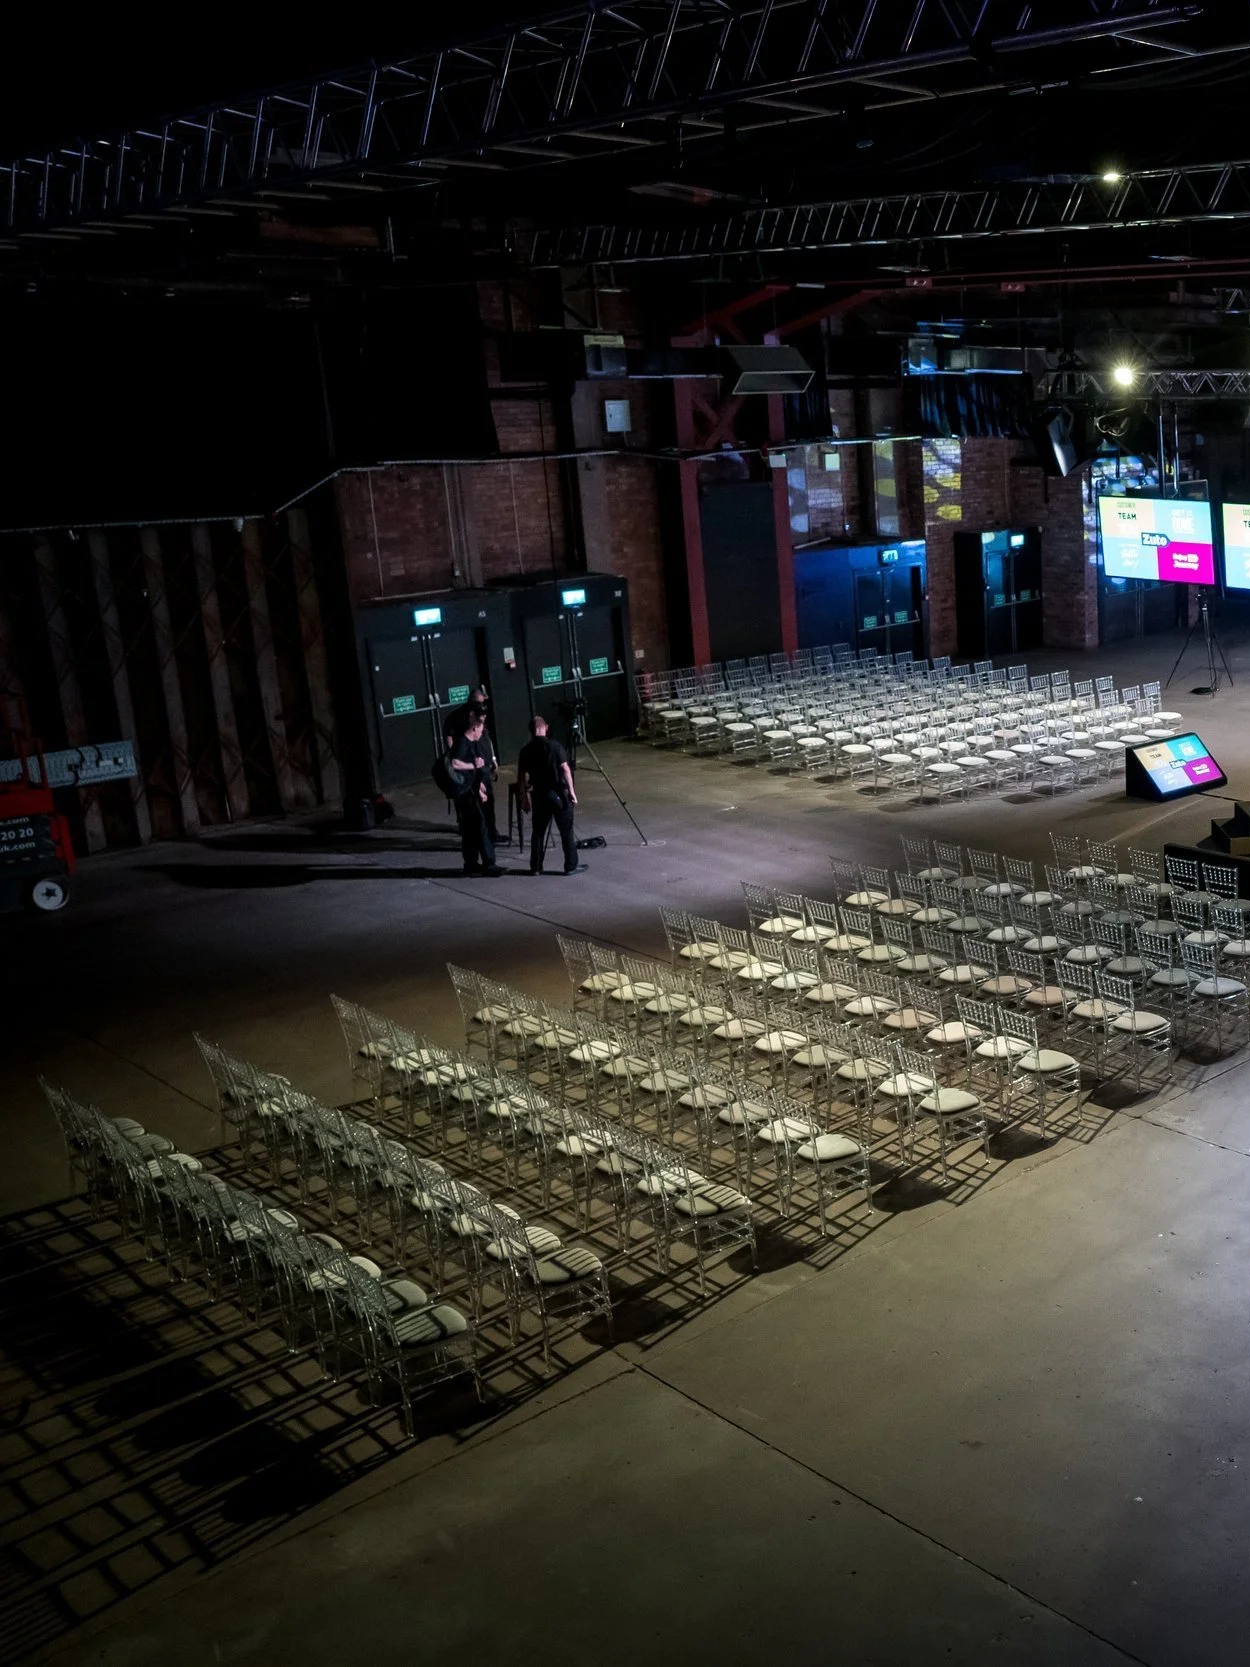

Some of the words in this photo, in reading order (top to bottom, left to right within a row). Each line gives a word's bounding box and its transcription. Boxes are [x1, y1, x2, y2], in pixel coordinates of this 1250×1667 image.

[1118, 512, 1137, 521] TEAM
[0, 831, 16, 841] 20
[19, 827, 34, 838] 20
